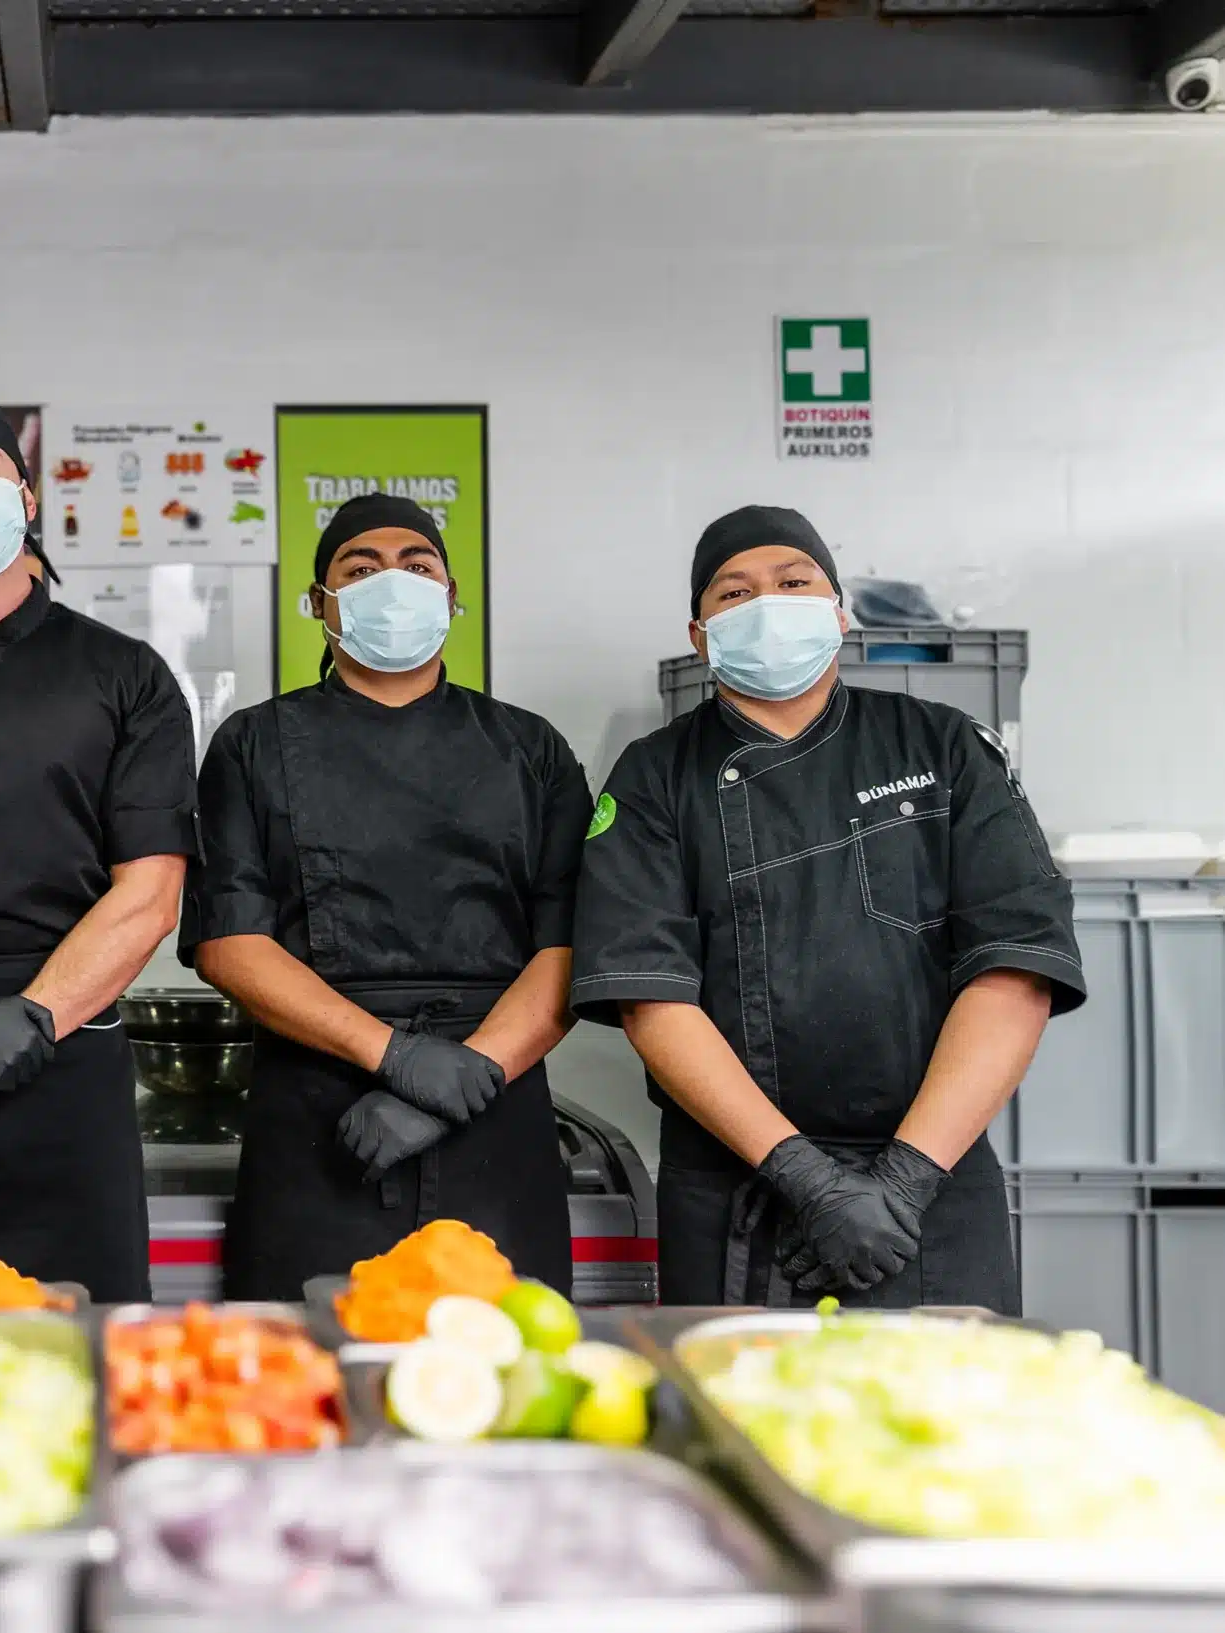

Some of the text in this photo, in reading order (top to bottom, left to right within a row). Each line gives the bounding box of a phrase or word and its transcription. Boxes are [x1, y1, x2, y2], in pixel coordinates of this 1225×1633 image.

[784, 405, 871, 422] BOTIQUÍN
[783, 426, 873, 439] PRIMEROS
[786, 443, 870, 457] AUXILIOS
[856, 771, 936, 805] DÚNAMAI
